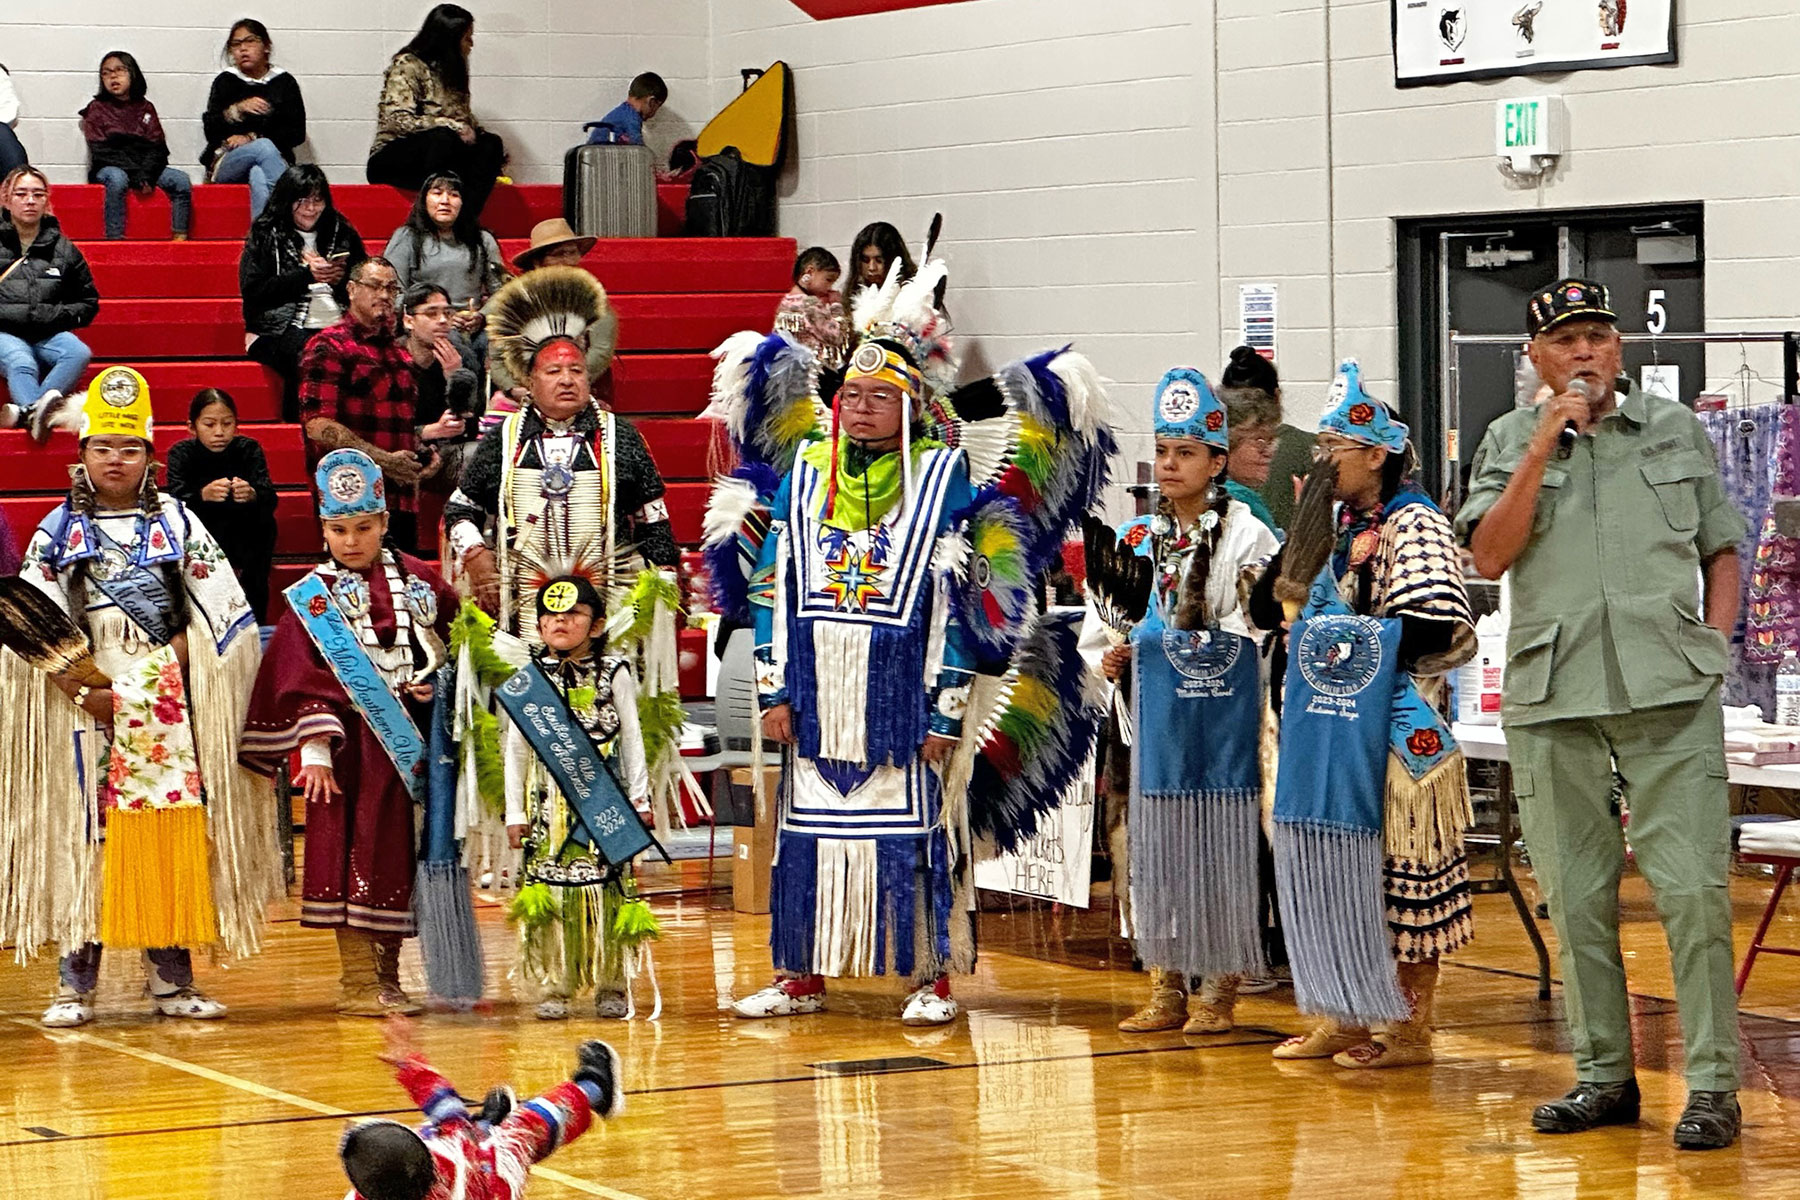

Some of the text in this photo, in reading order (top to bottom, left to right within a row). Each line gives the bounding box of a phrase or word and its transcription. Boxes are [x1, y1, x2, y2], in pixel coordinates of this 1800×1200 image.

[1505, 102, 1538, 147] EXIT
[1646, 289, 1666, 335] 5
[350, 675, 394, 739] Southern
[1312, 694, 1356, 708] 2023-2024
[523, 702, 592, 800] Brave Alternate
[541, 705, 597, 782] Southern Ute
[593, 805, 618, 827] 2023
[602, 815, 626, 837] 2024
[1015, 860, 1056, 897] HERE
